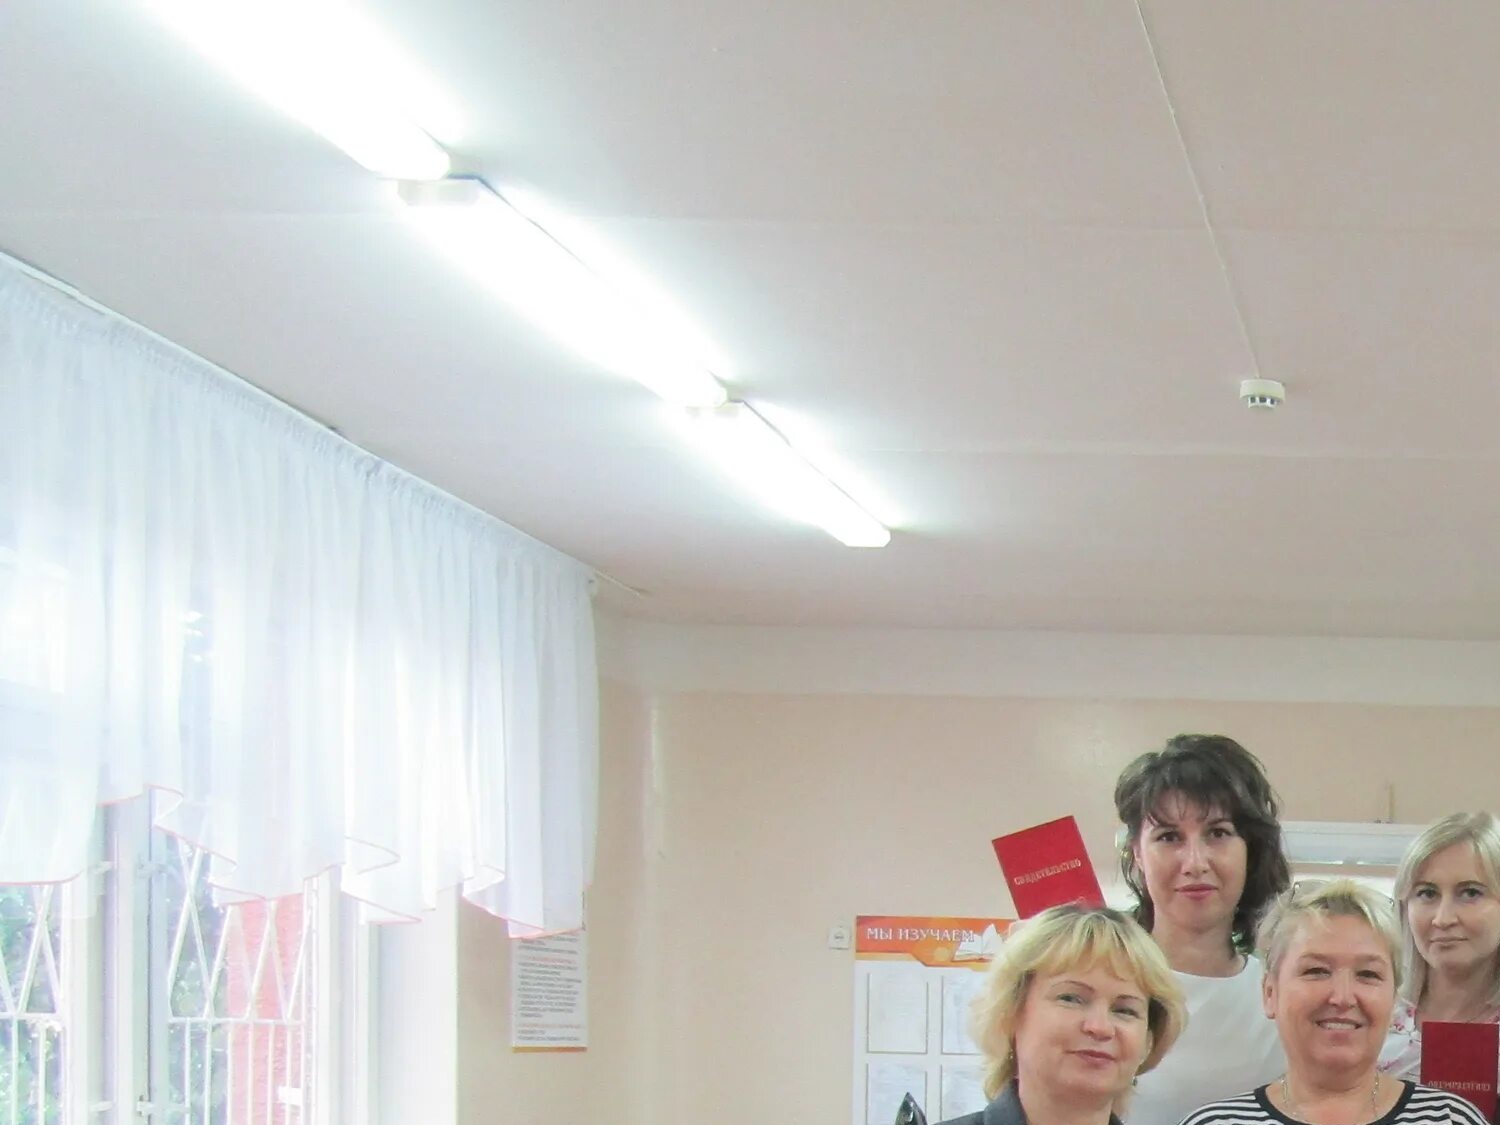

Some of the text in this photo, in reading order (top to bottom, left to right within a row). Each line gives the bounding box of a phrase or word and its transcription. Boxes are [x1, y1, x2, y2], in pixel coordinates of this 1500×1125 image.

[1013, 858, 1082, 886] СВИДЕТЕЛЬСТВО
[866, 927, 975, 943] МЫ ИЗУЧАЕМ
